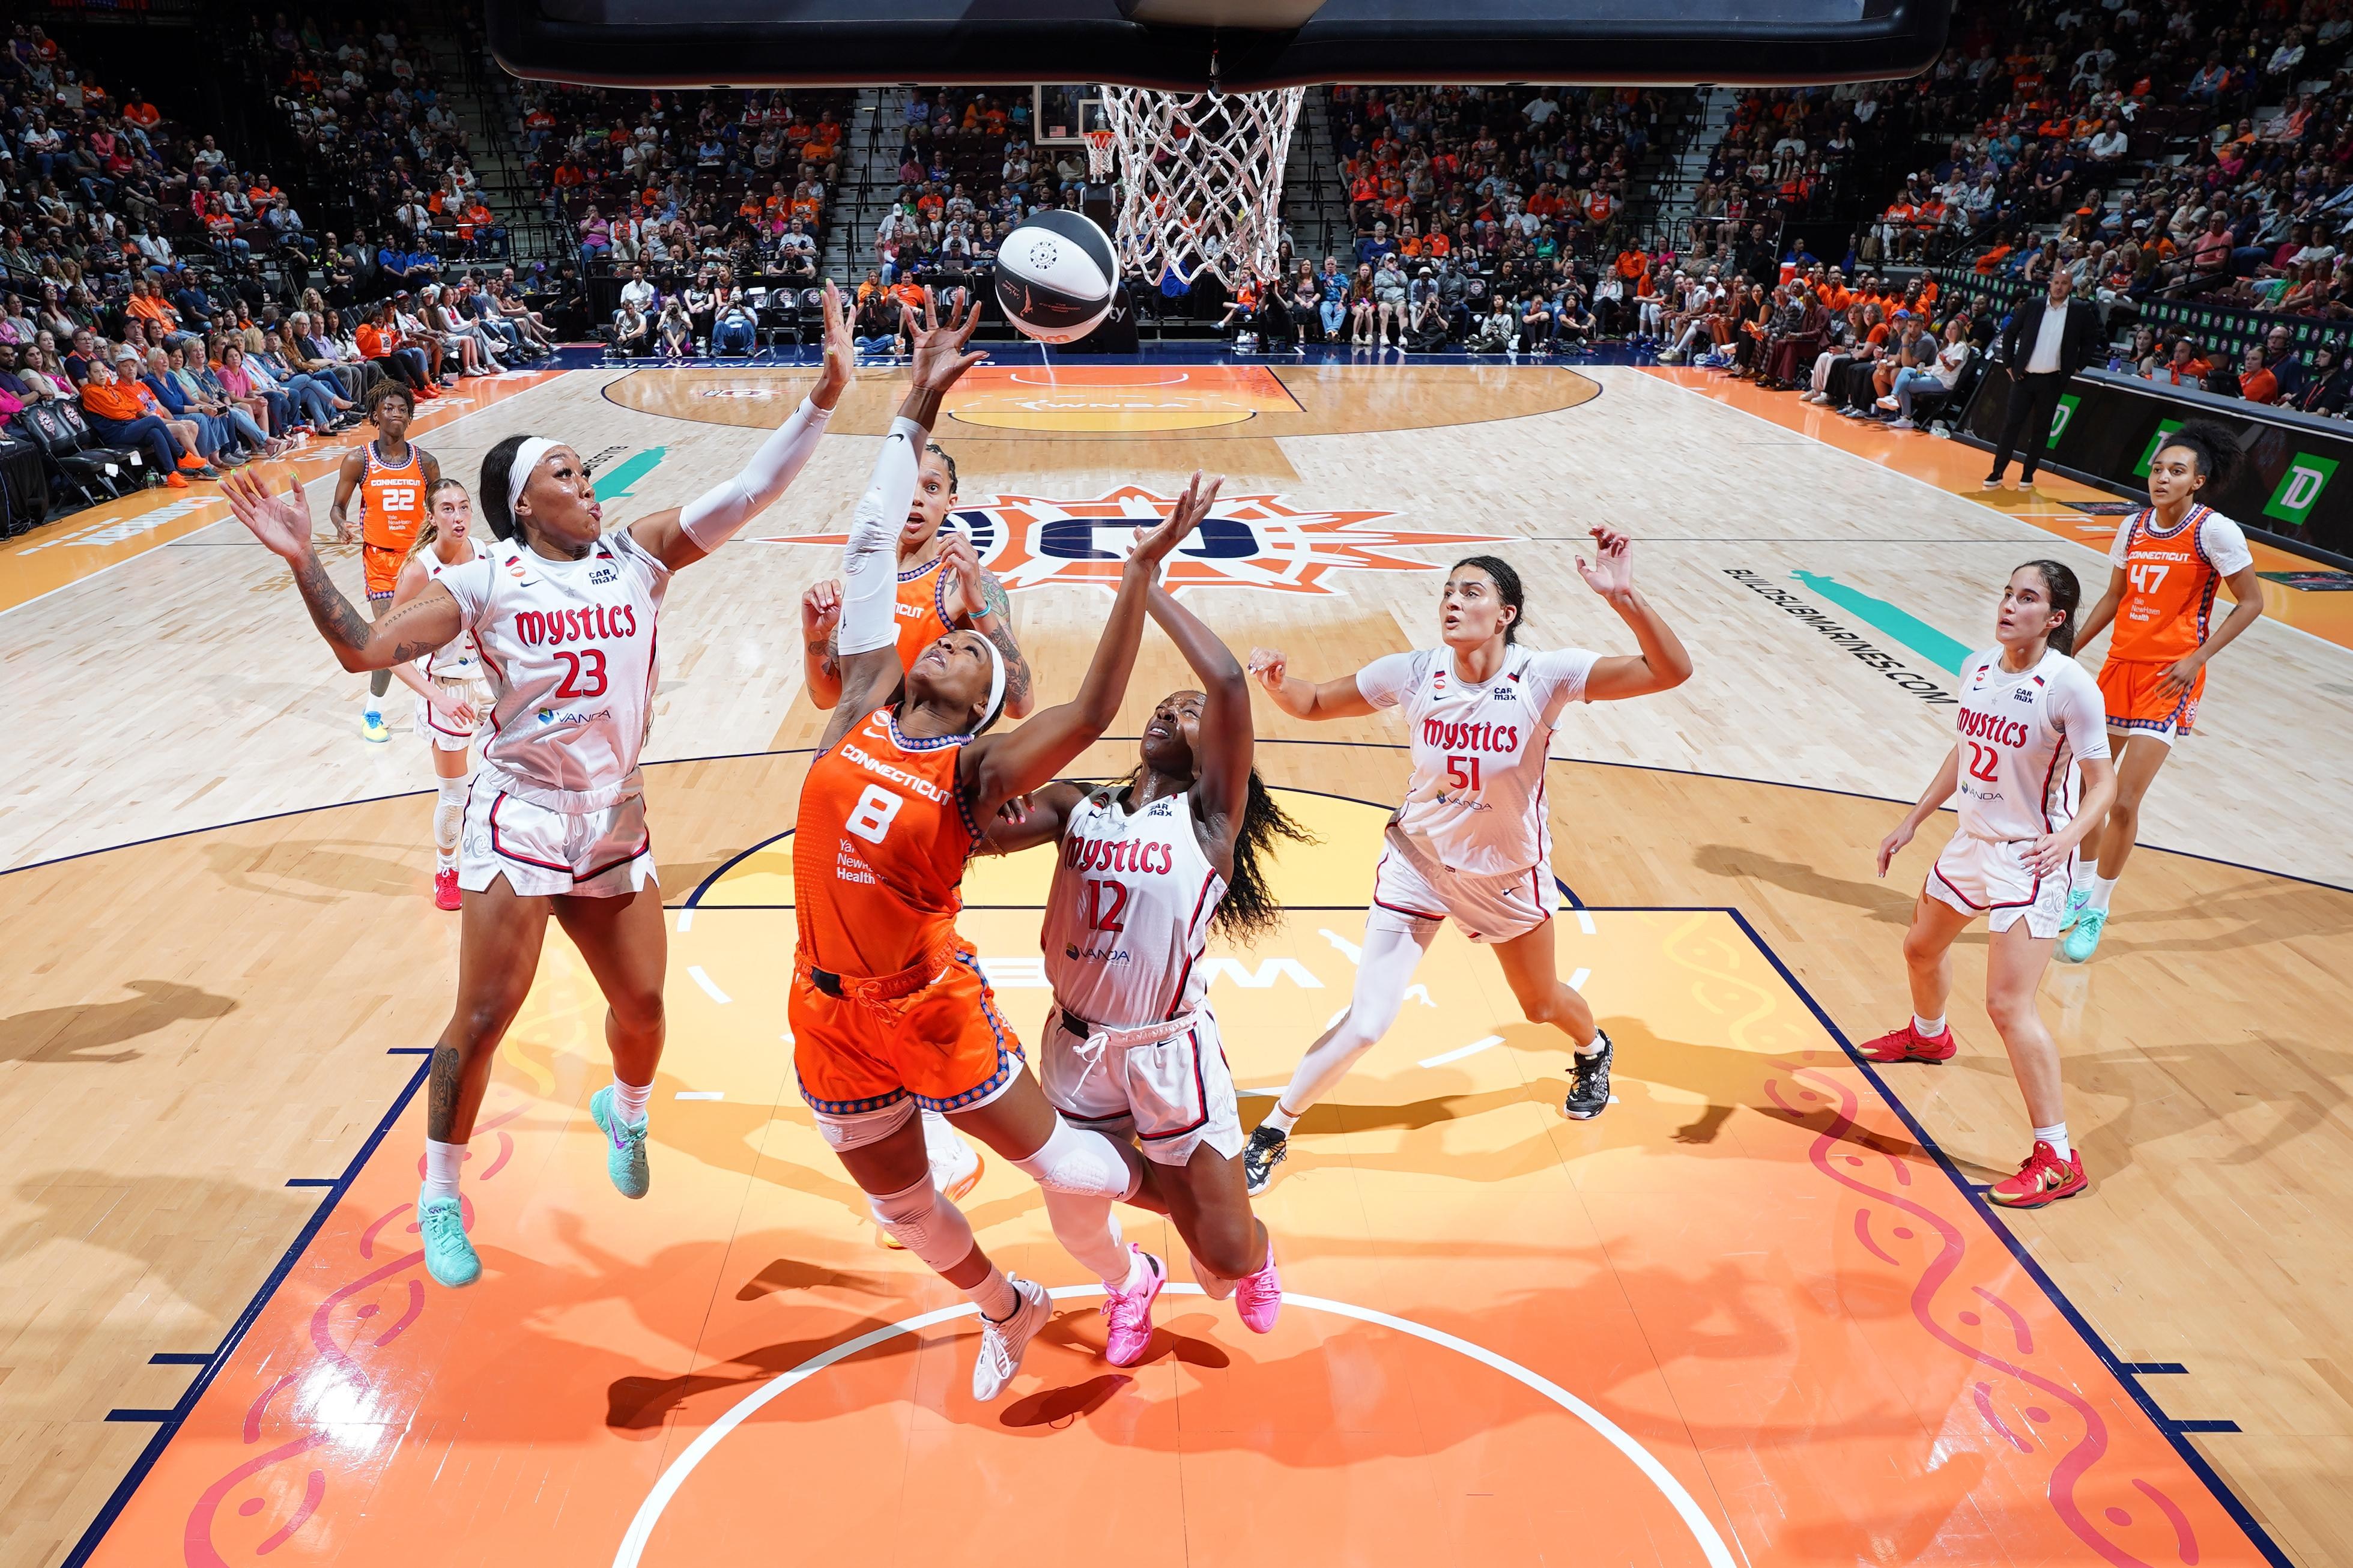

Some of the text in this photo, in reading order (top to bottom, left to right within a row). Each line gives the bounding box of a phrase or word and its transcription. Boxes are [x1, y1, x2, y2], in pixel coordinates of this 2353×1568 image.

[2049, 404, 2071, 437] D
[383, 489, 415, 511] 22
[2280, 465, 2323, 509] TD
[589, 569, 611, 578] CAR
[2128, 551, 2191, 562] CONNECTICUT
[591, 574, 619, 586] max
[2130, 564, 2170, 595] 47
[515, 602, 637, 648] mystics
[2130, 612, 2149, 622] Health
[2131, 605, 2161, 616] NewHaven
[1722, 569, 1959, 704] BUILDSUBMARINES.COM
[553, 648, 608, 699] 23
[2014, 694, 2034, 704] max
[2016, 688, 2033, 697] CAR
[1423, 718, 1518, 753] mystics
[1957, 707, 2029, 748] mystics
[840, 743, 954, 807] CONNECTICUT
[1447, 755, 1480, 791] 51
[1968, 740, 1998, 782] 22
[845, 783, 903, 844] 8
[1447, 796, 1493, 811] VANDA
[1064, 835, 1172, 875] mystics
[837, 868, 876, 885] Health
[1088, 879, 1128, 933] 12
